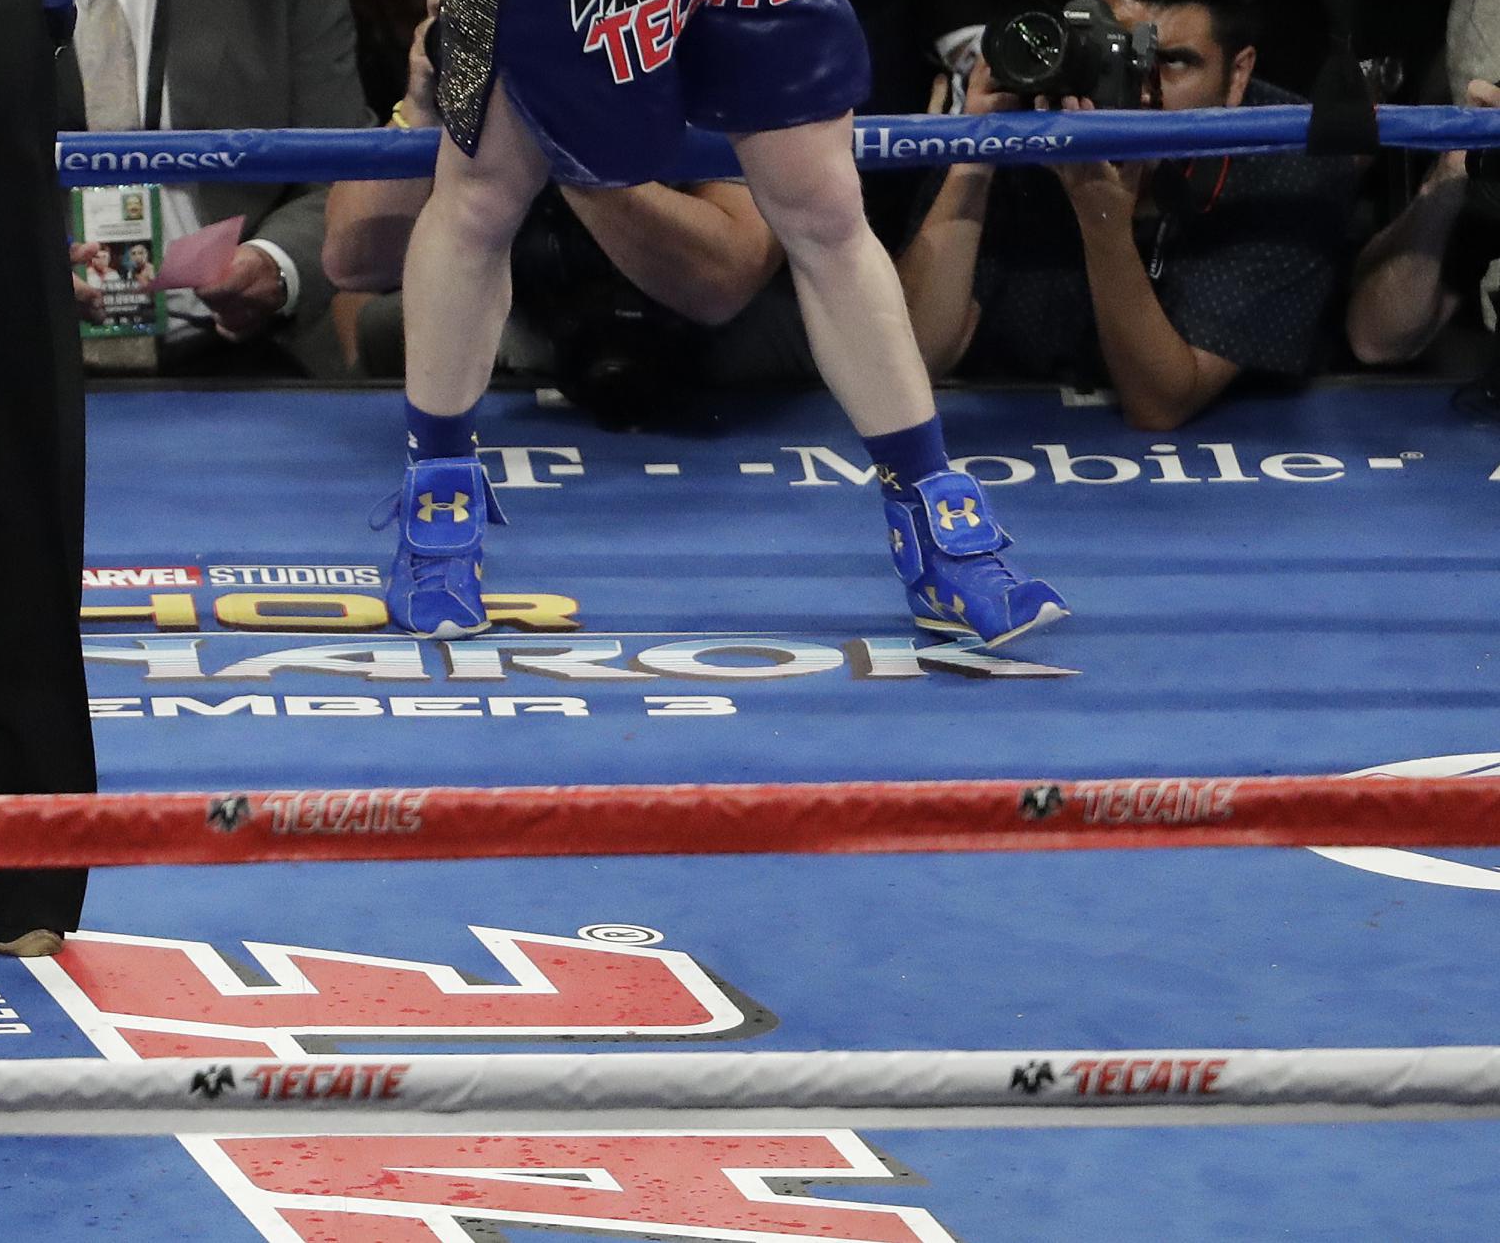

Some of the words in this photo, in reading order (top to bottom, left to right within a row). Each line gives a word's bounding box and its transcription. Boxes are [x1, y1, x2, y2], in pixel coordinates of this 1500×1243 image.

[54, 142, 246, 171] ennessy
[82, 568, 199, 587] ARVEL
[208, 567, 381, 587] STUDIOS
[644, 695, 737, 716] 3
[260, 790, 425, 834] TECATE
[1073, 779, 1240, 824] TECATE
[243, 1063, 412, 1100] TECATE
[1063, 1058, 1230, 1095] TECATE
